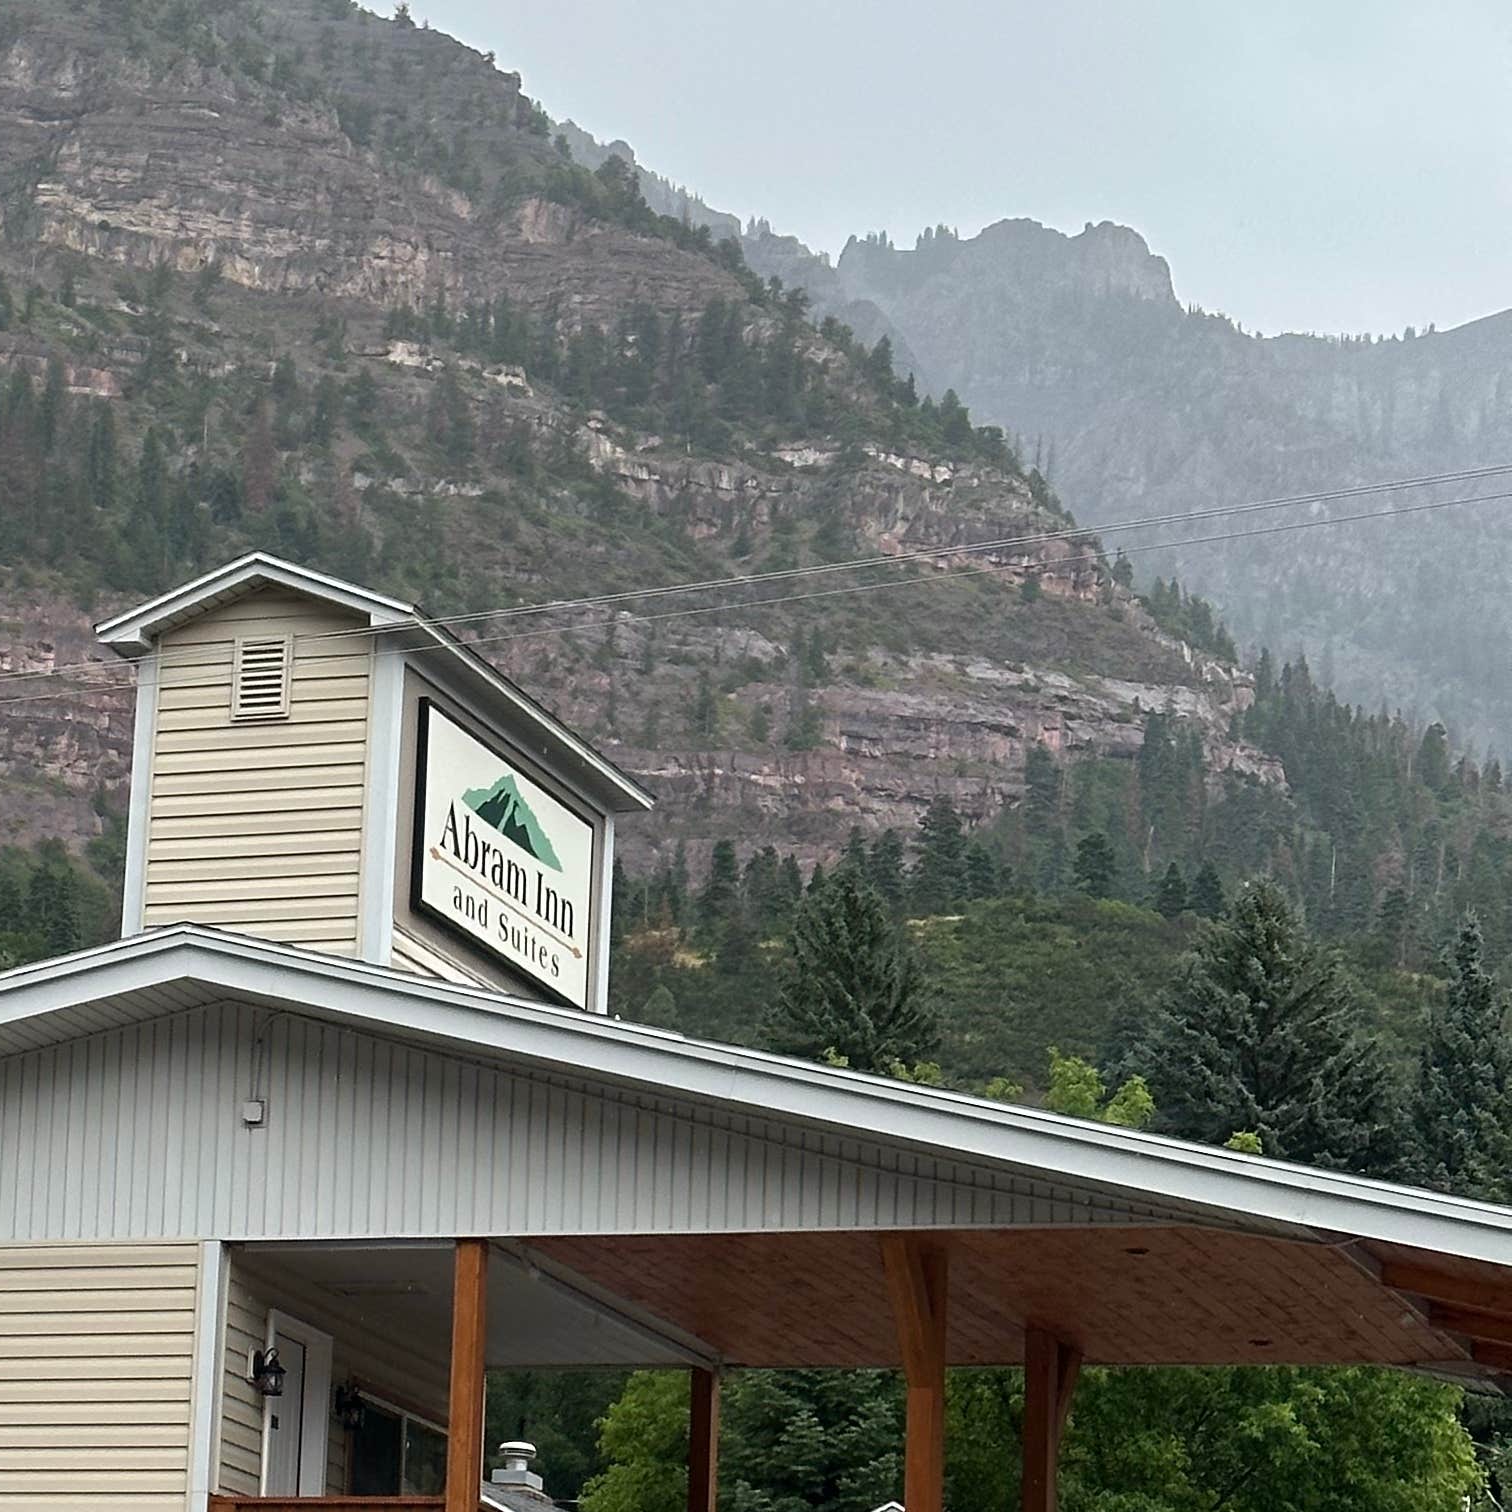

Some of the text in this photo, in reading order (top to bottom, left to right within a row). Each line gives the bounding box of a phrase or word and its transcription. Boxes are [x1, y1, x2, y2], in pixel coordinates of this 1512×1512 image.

[439, 799, 575, 939] Abram Inn
[452, 884, 561, 978] and Suites
